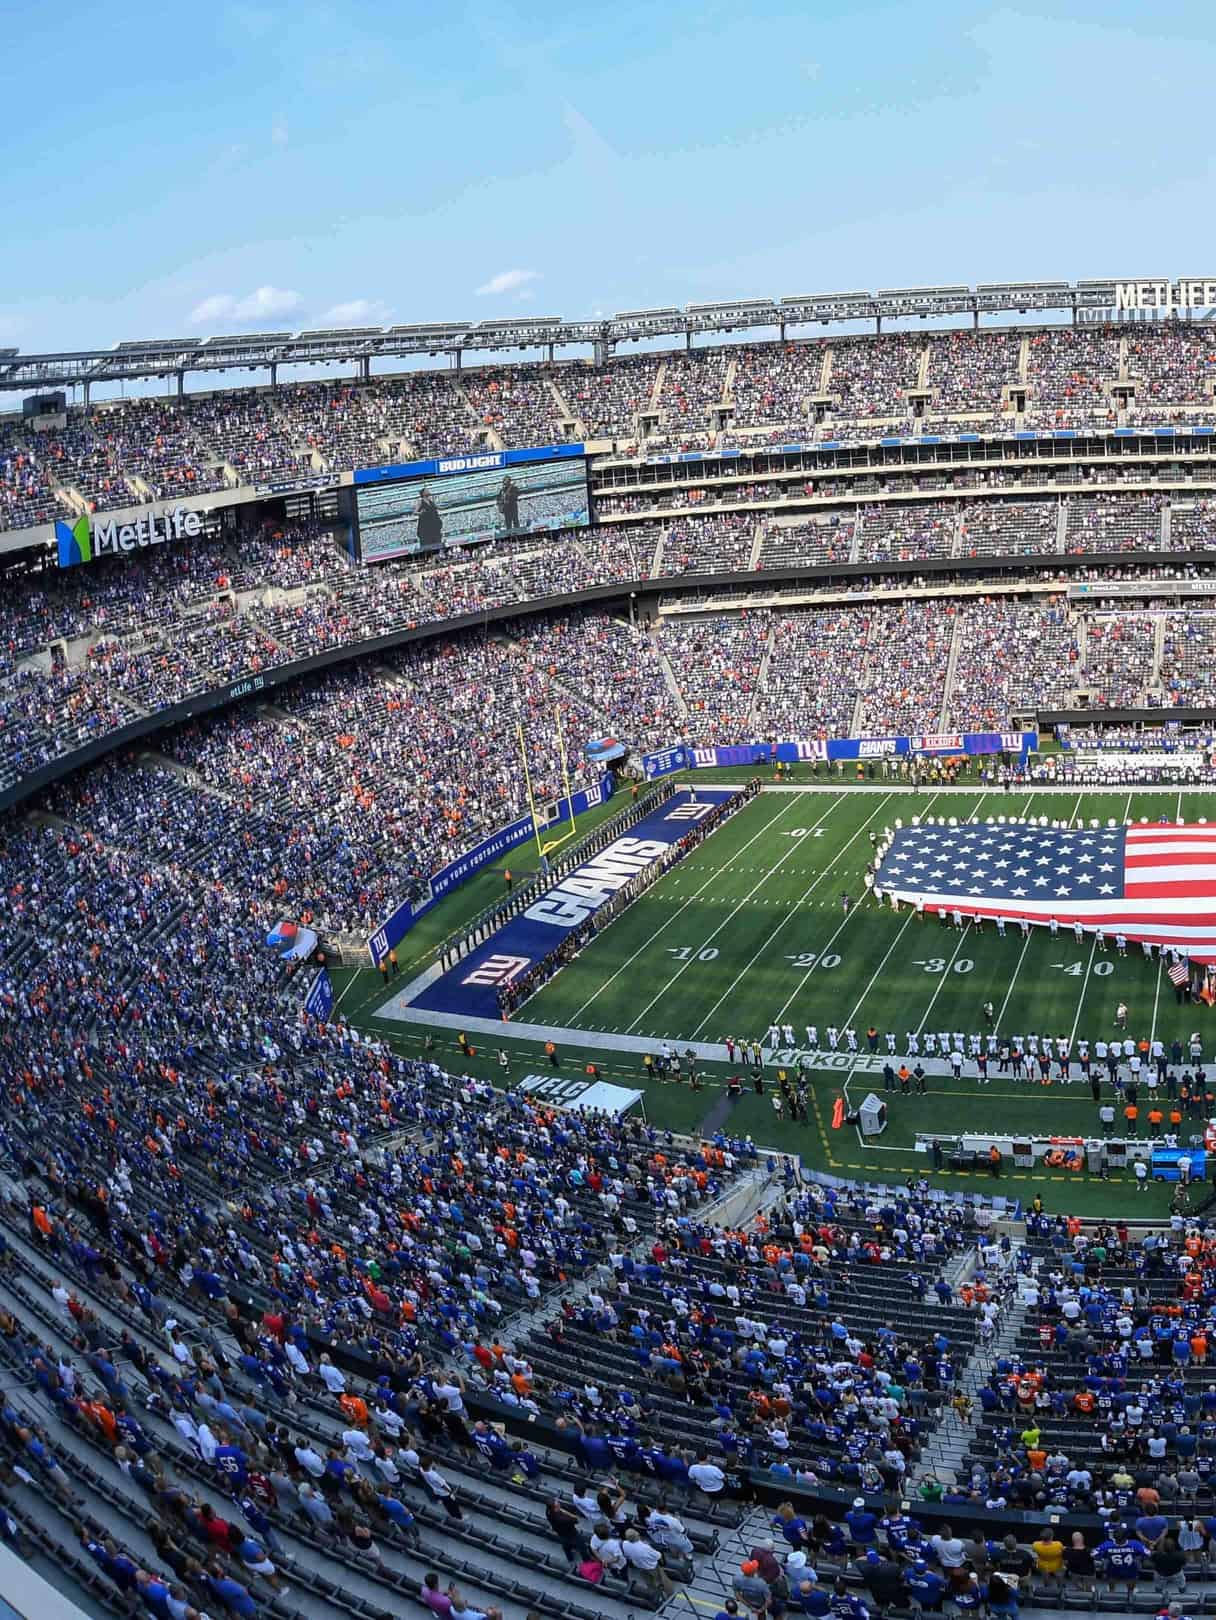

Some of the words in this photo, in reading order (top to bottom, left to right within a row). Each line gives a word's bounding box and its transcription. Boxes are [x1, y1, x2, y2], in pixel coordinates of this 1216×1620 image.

[1115, 282, 1216, 309] METLIFE
[439, 459, 466, 473] BUD
[467, 456, 503, 470] LIGHT
[94, 505, 201, 557] MetLife
[858, 741, 897, 757] GIANTS
[434, 877, 449, 893] NEW
[450, 863, 469, 881] YORK
[470, 840, 504, 868] FOOTBALL
[505, 823, 533, 844] GIANTS
[523, 837, 670, 928] GIANTS
[671, 946, 720, 961] 10
[791, 952, 842, 968] 20
[923, 958, 975, 973] 30
[1063, 960, 1115, 976] 40
[768, 1050, 883, 1069] KICKOFF
[515, 1074, 590, 1097] WELC
[1111, 1554, 1133, 1566] 64
